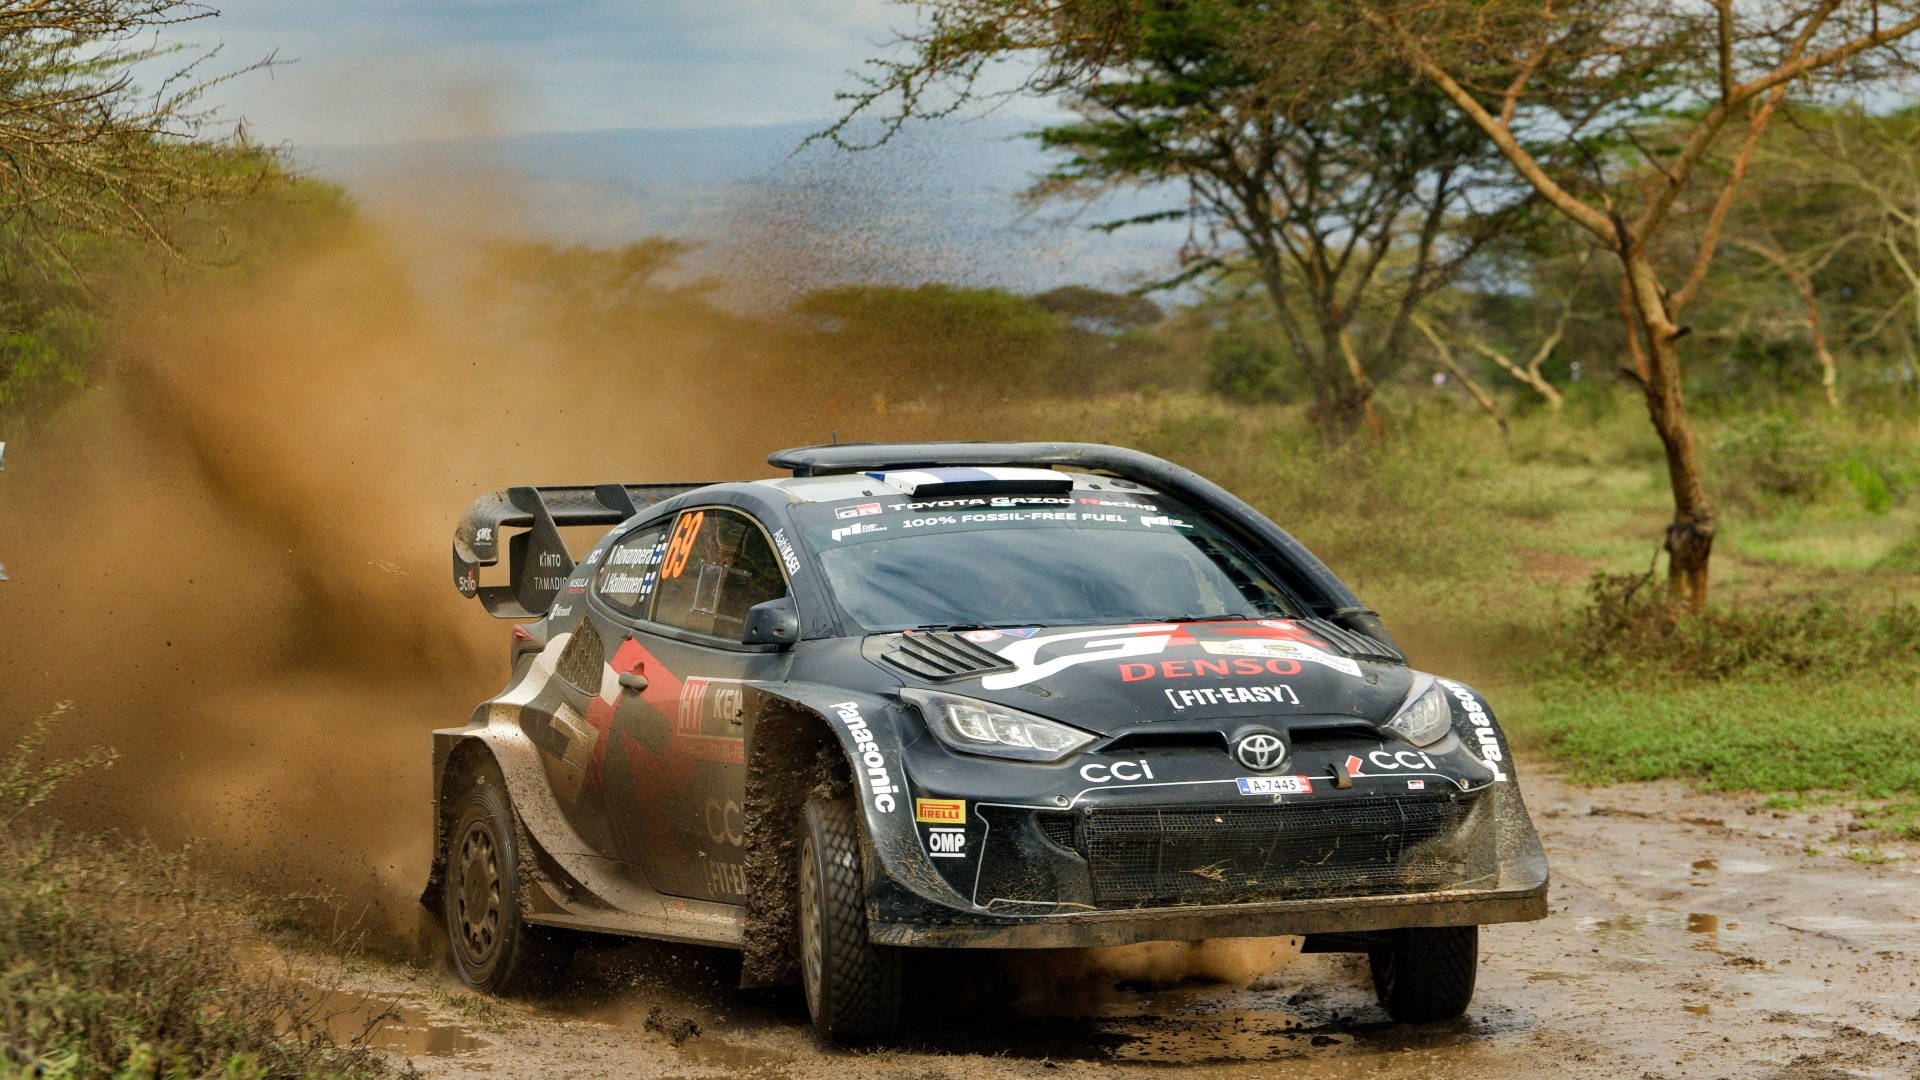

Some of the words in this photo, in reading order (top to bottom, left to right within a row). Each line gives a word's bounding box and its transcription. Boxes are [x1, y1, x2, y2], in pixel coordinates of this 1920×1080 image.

[837, 505, 880, 519] GR
[888, 498, 985, 511] TOYOTA
[991, 497, 1075, 505] GAZOO
[1080, 498, 1158, 512] Racing
[902, 516, 957, 528] 100%
[961, 512, 1077, 523] FOSSIL-FREE
[1082, 513, 1127, 522] FUEL
[662, 511, 704, 579] 69
[773, 527, 801, 576] AsahiKASEI
[1118, 658, 1303, 682] DENSO
[681, 684, 706, 729] HY
[713, 688, 743, 720] KEN
[1164, 684, 1299, 709] [FIT-EASY]
[829, 701, 899, 813] Panasonic
[1253, 779, 1296, 791] A-7445
[919, 803, 960, 819] PIRELLI
[707, 800, 744, 847] CC
[929, 833, 966, 852] OMP
